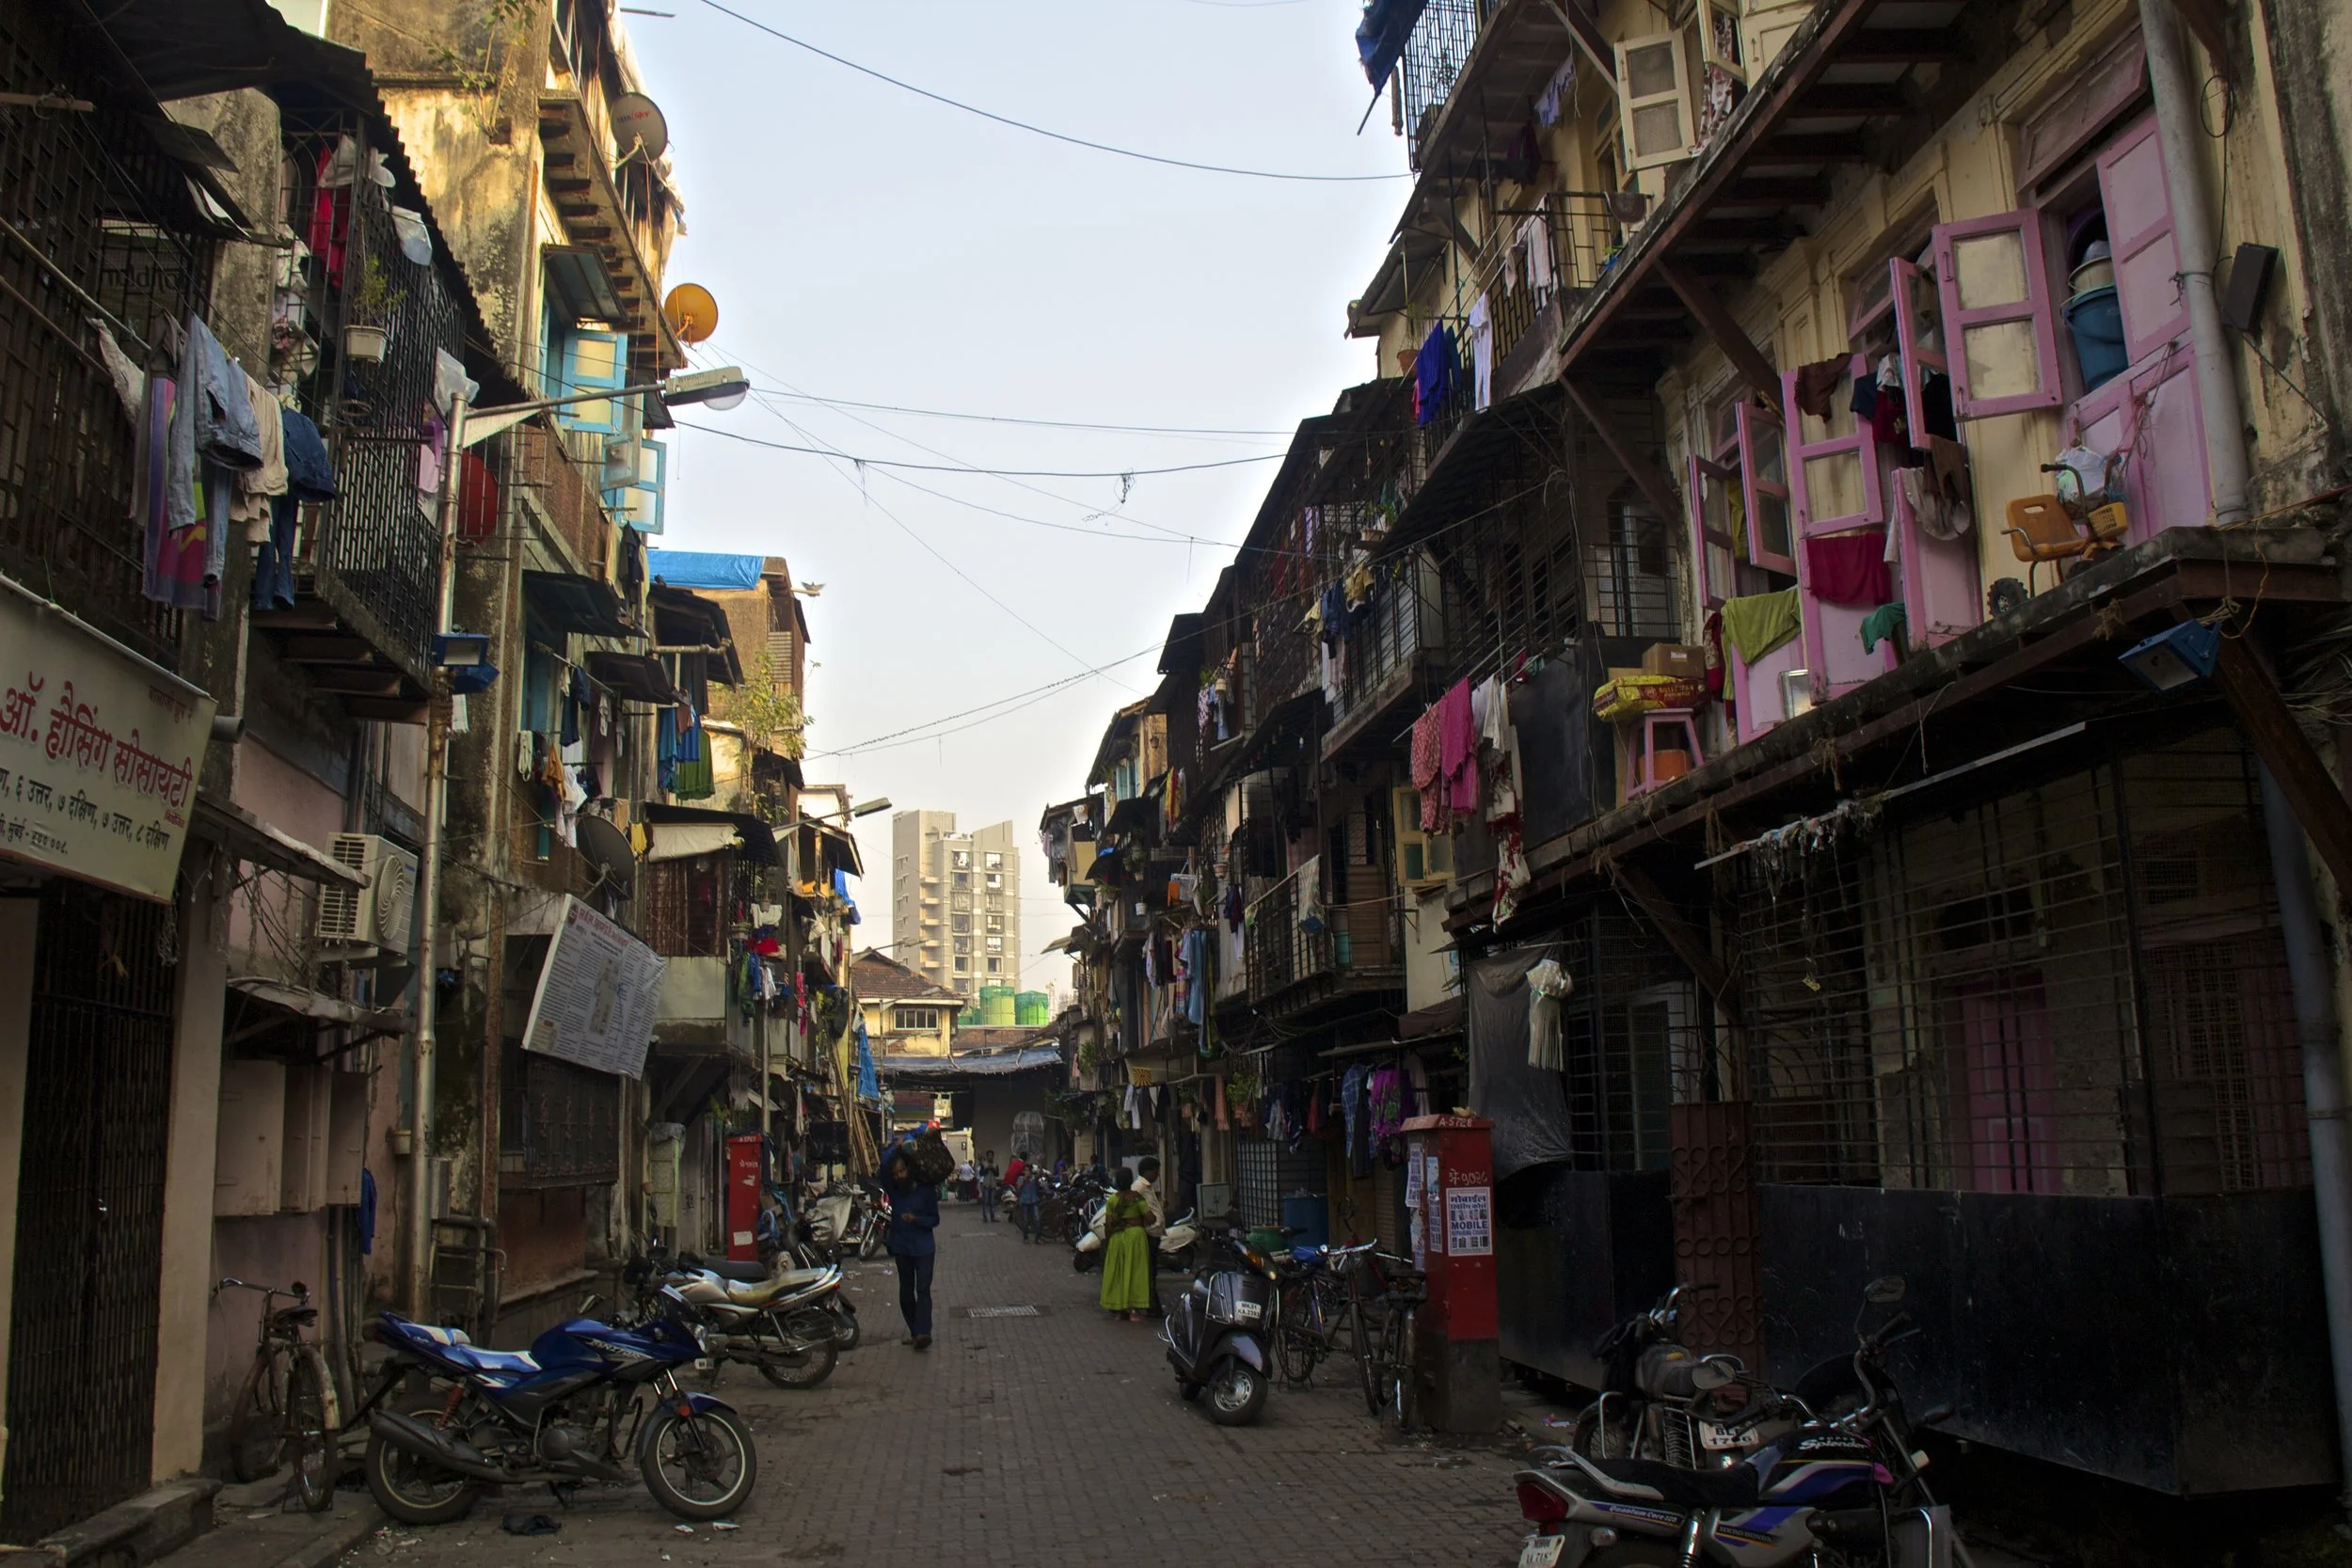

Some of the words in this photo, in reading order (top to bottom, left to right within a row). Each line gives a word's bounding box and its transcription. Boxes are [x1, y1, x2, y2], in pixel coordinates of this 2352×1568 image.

[114, 728, 192, 808] सोसायटी
[28, 780, 54, 813] उत्तर,
[57, 795, 66, 812] ७
[69, 789, 98, 830] दक्षिण,
[103, 812, 110, 828] ७
[112, 812, 134, 842] उत्तर,
[135, 824, 144, 842] ८
[145, 820, 170, 850] दक्षिण
[8, 816, 27, 842] मुंबई
[1451, 1220, 1487, 1229] MOBILE
[1709, 1436, 1752, 1445] 176
[1798, 1438, 1867, 1450] Splendor
